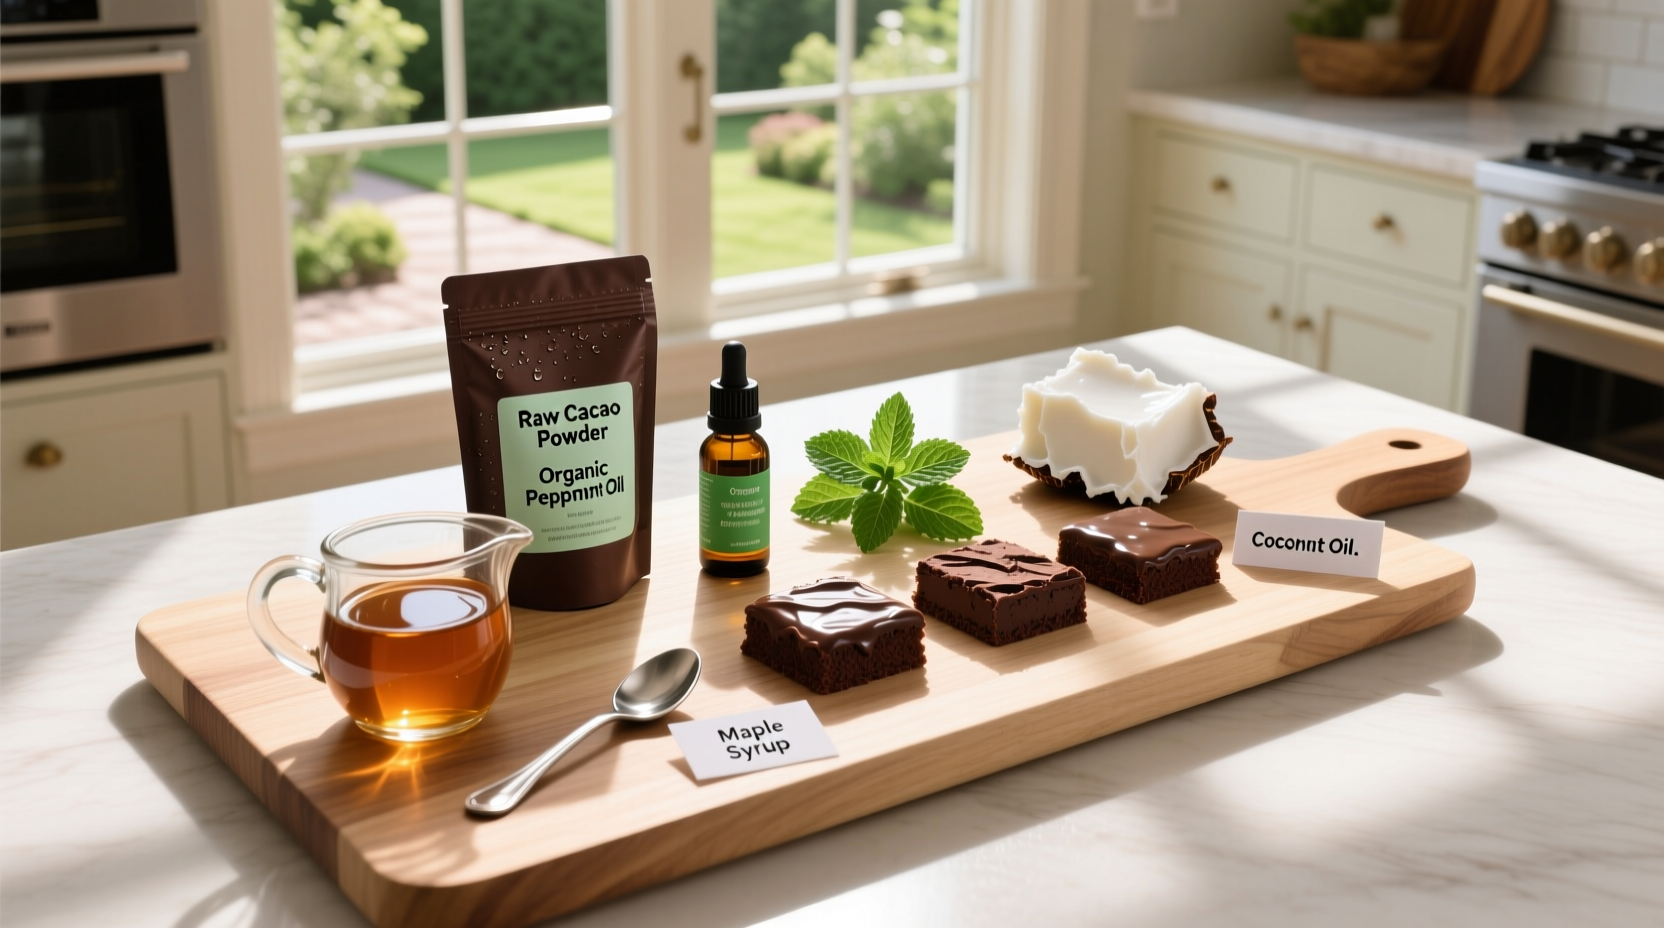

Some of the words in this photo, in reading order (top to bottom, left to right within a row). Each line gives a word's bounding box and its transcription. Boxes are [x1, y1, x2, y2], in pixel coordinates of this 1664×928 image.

[518, 410, 560, 428] Raw
[564, 402, 621, 422] Cacao
[537, 423, 609, 448] Powder
[539, 460, 609, 487] Organic
[1329, 538, 1359, 556] Oil.
[717, 720, 784, 743] Maple
[726, 739, 791, 761] Syrup
